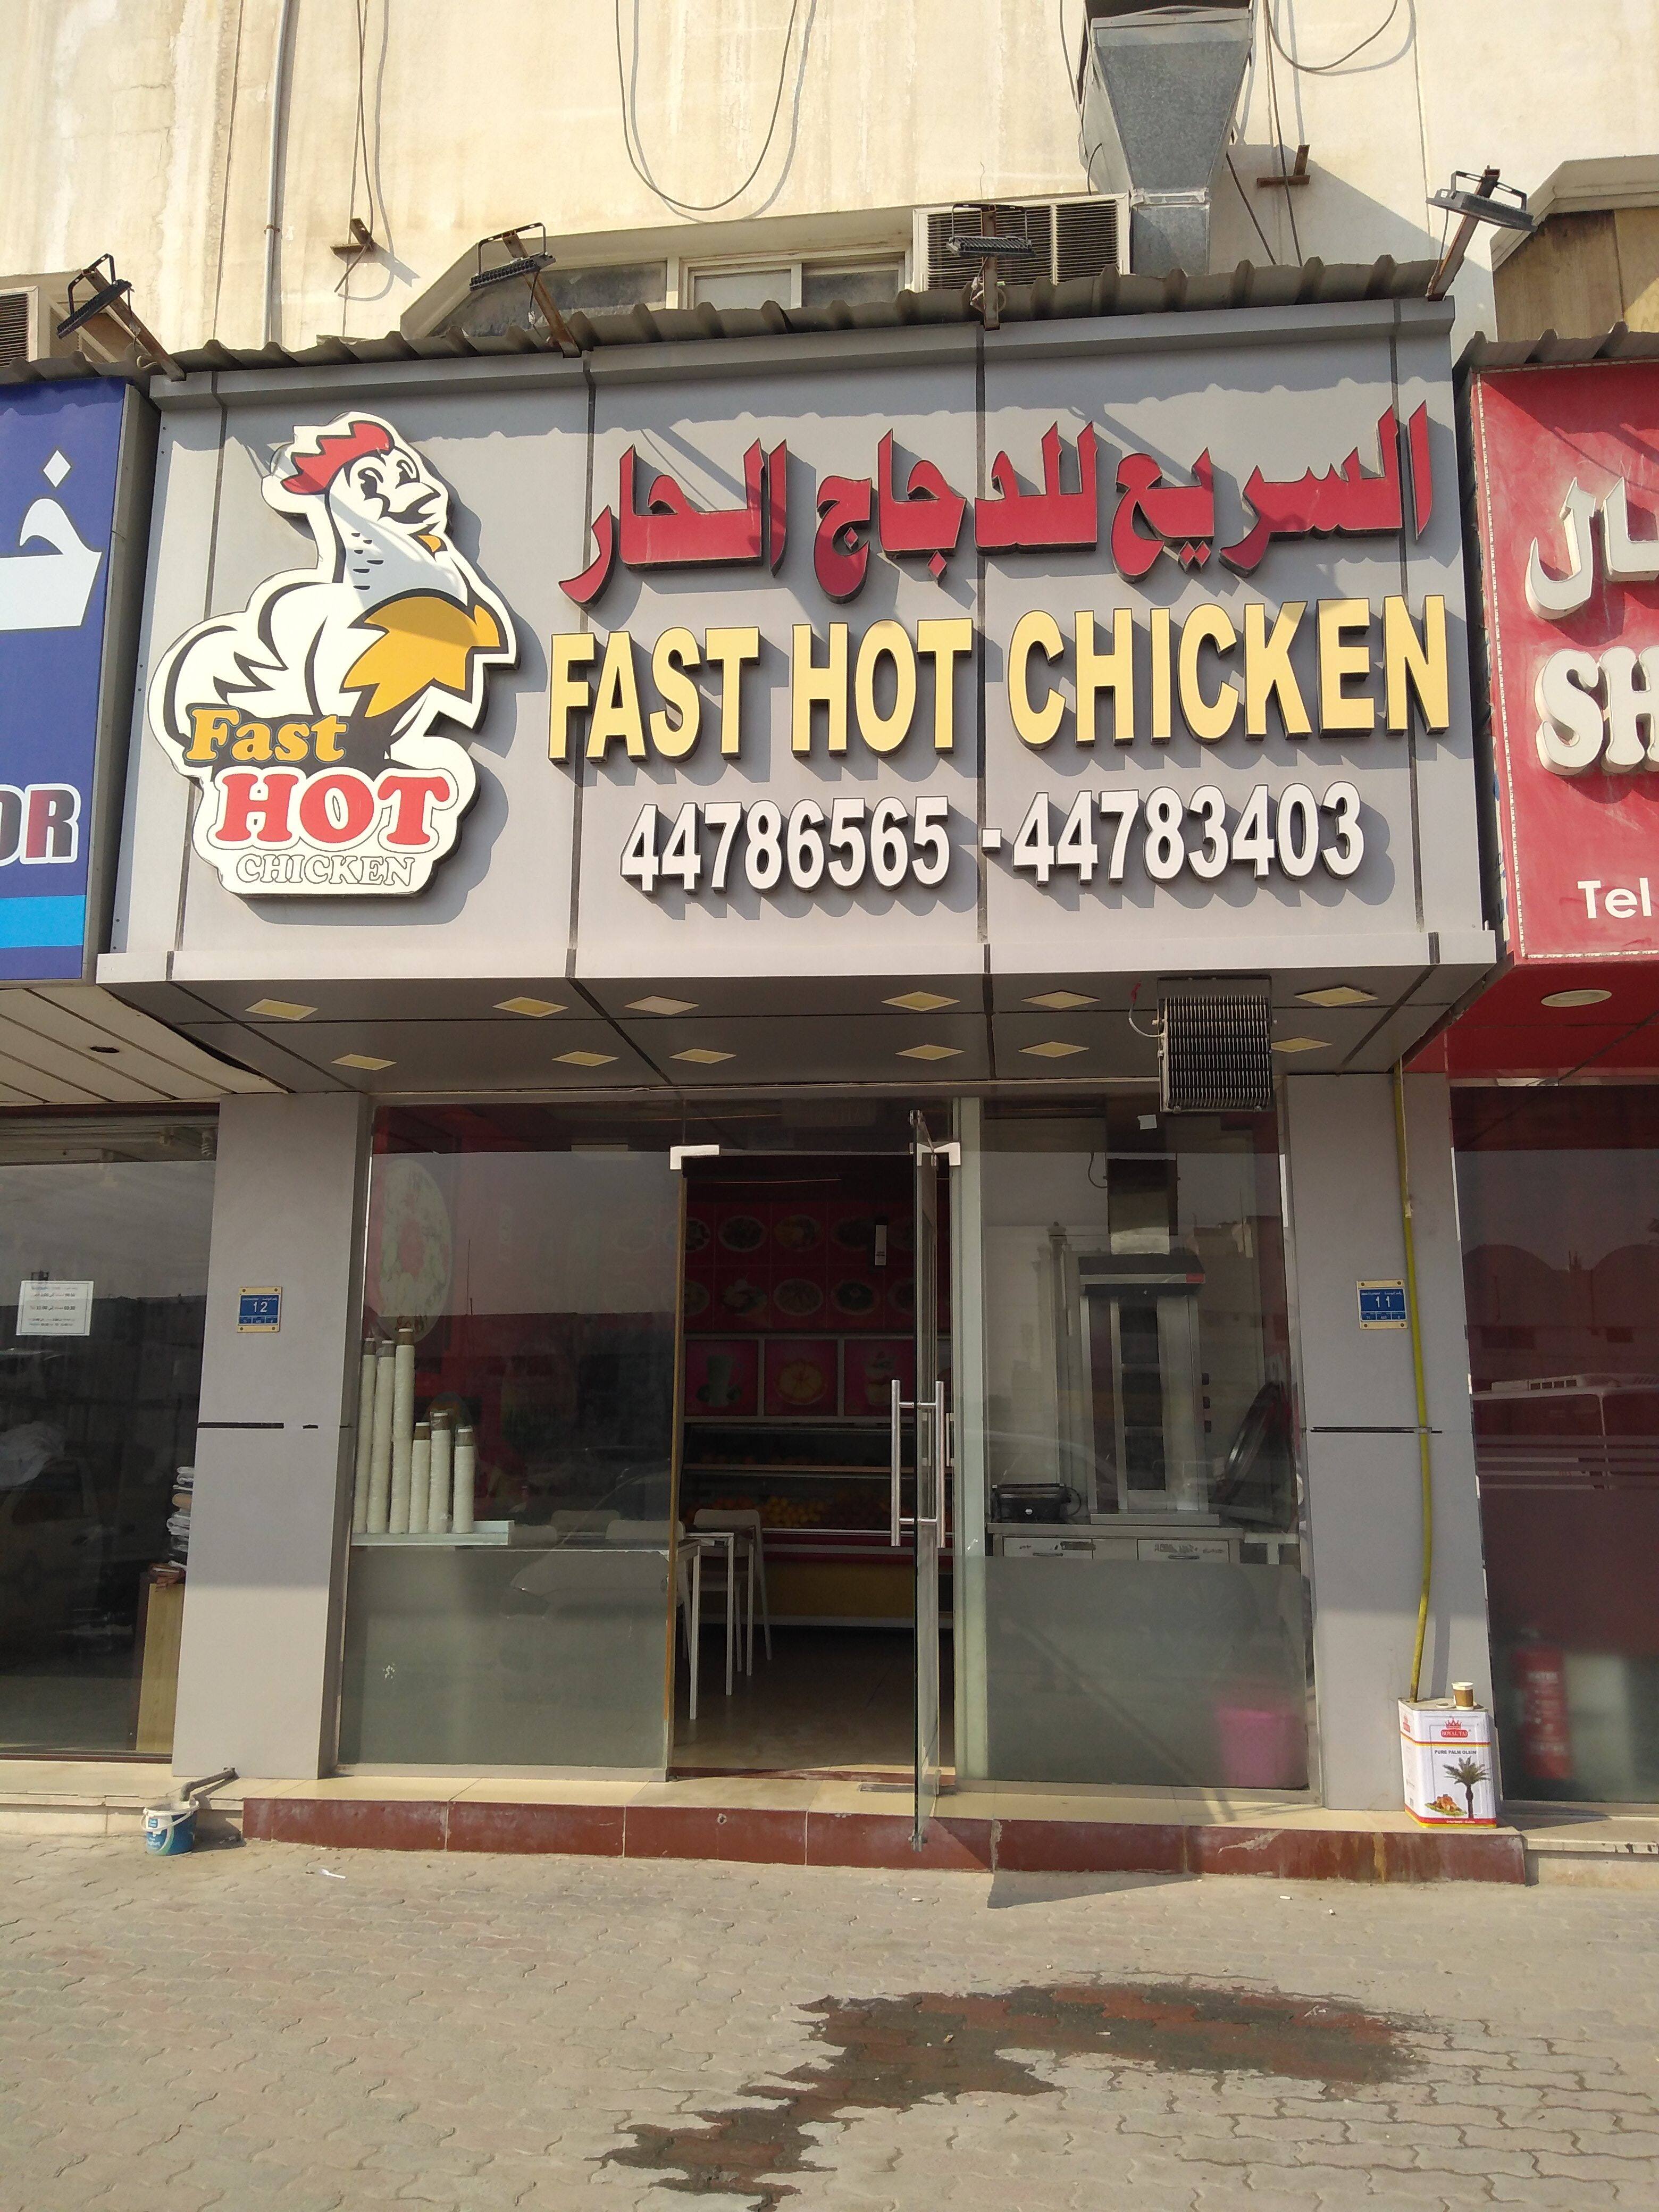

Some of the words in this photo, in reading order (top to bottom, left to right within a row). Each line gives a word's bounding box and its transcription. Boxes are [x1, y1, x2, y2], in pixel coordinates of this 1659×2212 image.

[558, 438, 787, 610] الحار
[814, 420, 1097, 604] للدجاج
[1111, 400, 1433, 583] السريع
[548, 626, 760, 765] FAST
[792, 618, 973, 758] HOT
[1008, 594, 1450, 750] CHICKEN
[185, 707, 348, 763] Fast
[215, 773, 450, 845] HOT
[620, 795, 950, 895] 44786565
[1012, 782, 1364, 886] 44783403
[237, 853, 415, 886] CHICKEN
[1577, 877, 1652, 919] Tel
[253, 1301, 267, 1312] 12
[1376, 1296, 1390, 1308] 11
